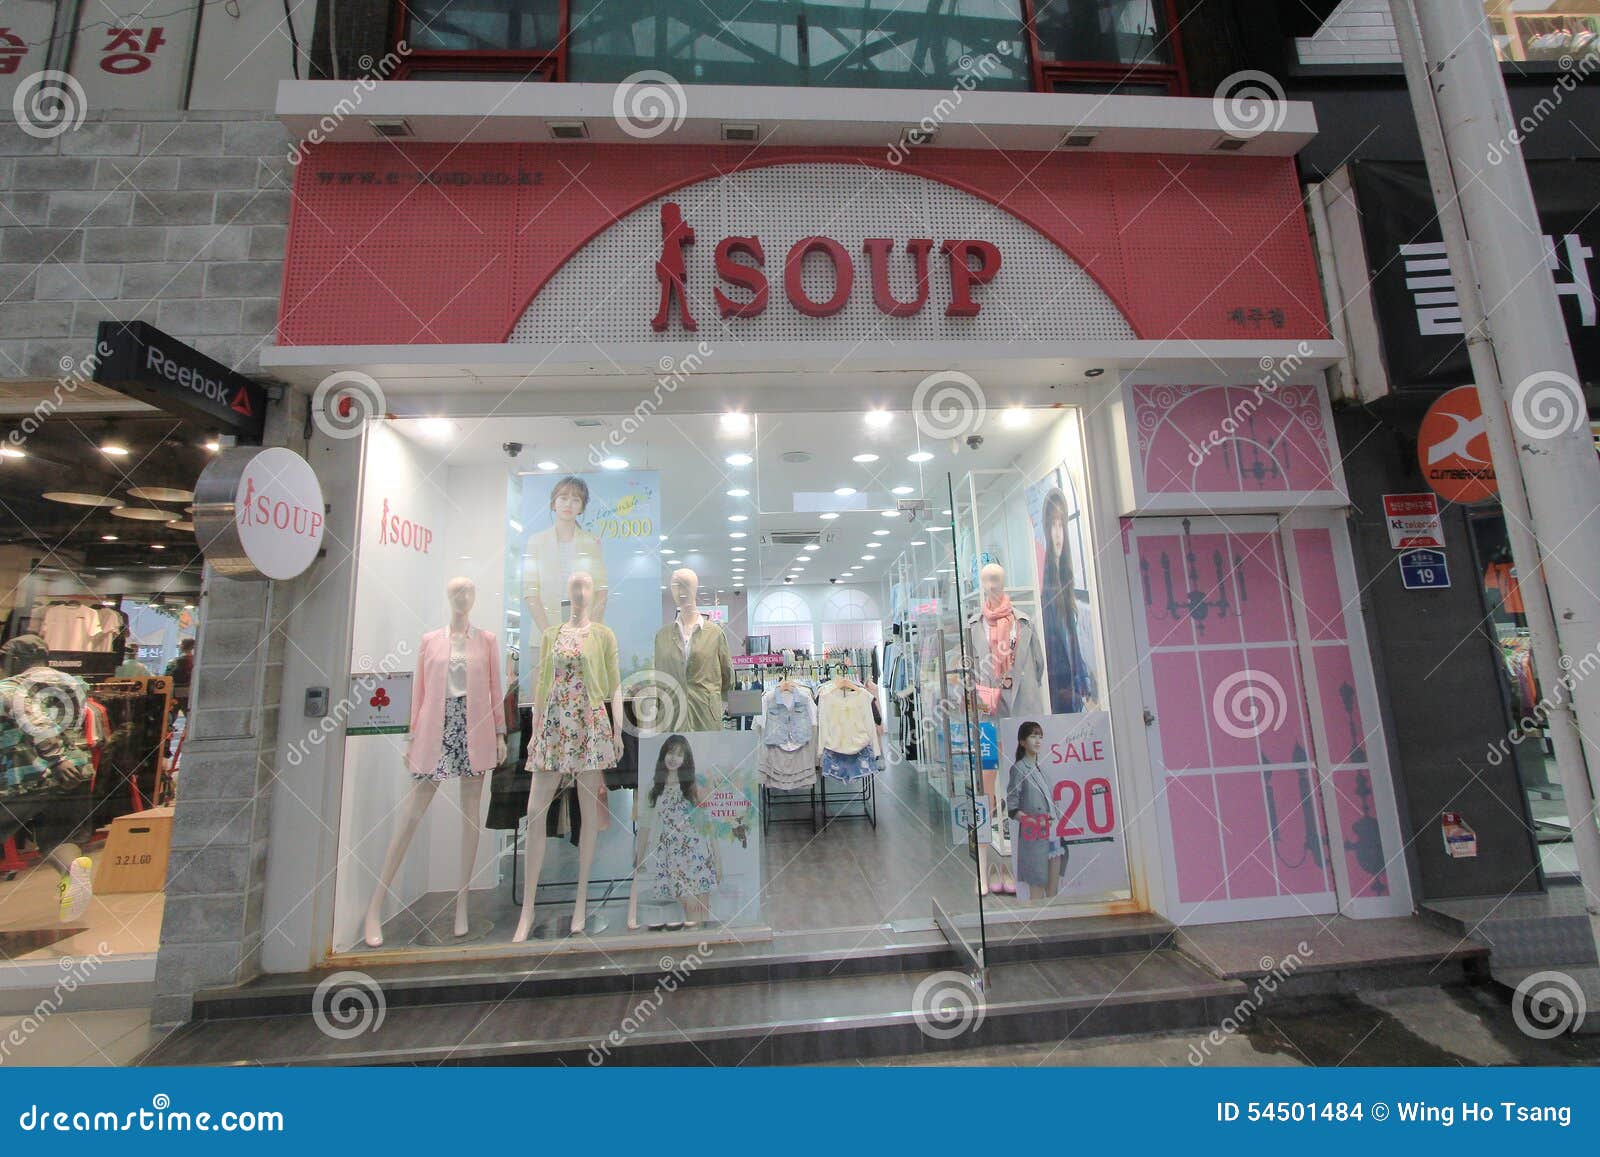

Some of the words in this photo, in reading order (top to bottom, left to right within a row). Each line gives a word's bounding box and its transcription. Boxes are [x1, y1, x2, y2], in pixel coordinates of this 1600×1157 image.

[713, 235, 1002, 320] SOUP
[146, 345, 229, 406] Reebok
[256, 495, 323, 538] SOUP
[389, 515, 433, 554] SOUP
[1416, 568, 1435, 584] 19
[1051, 741, 1105, 764] SALE
[1052, 777, 1116, 837] 20
